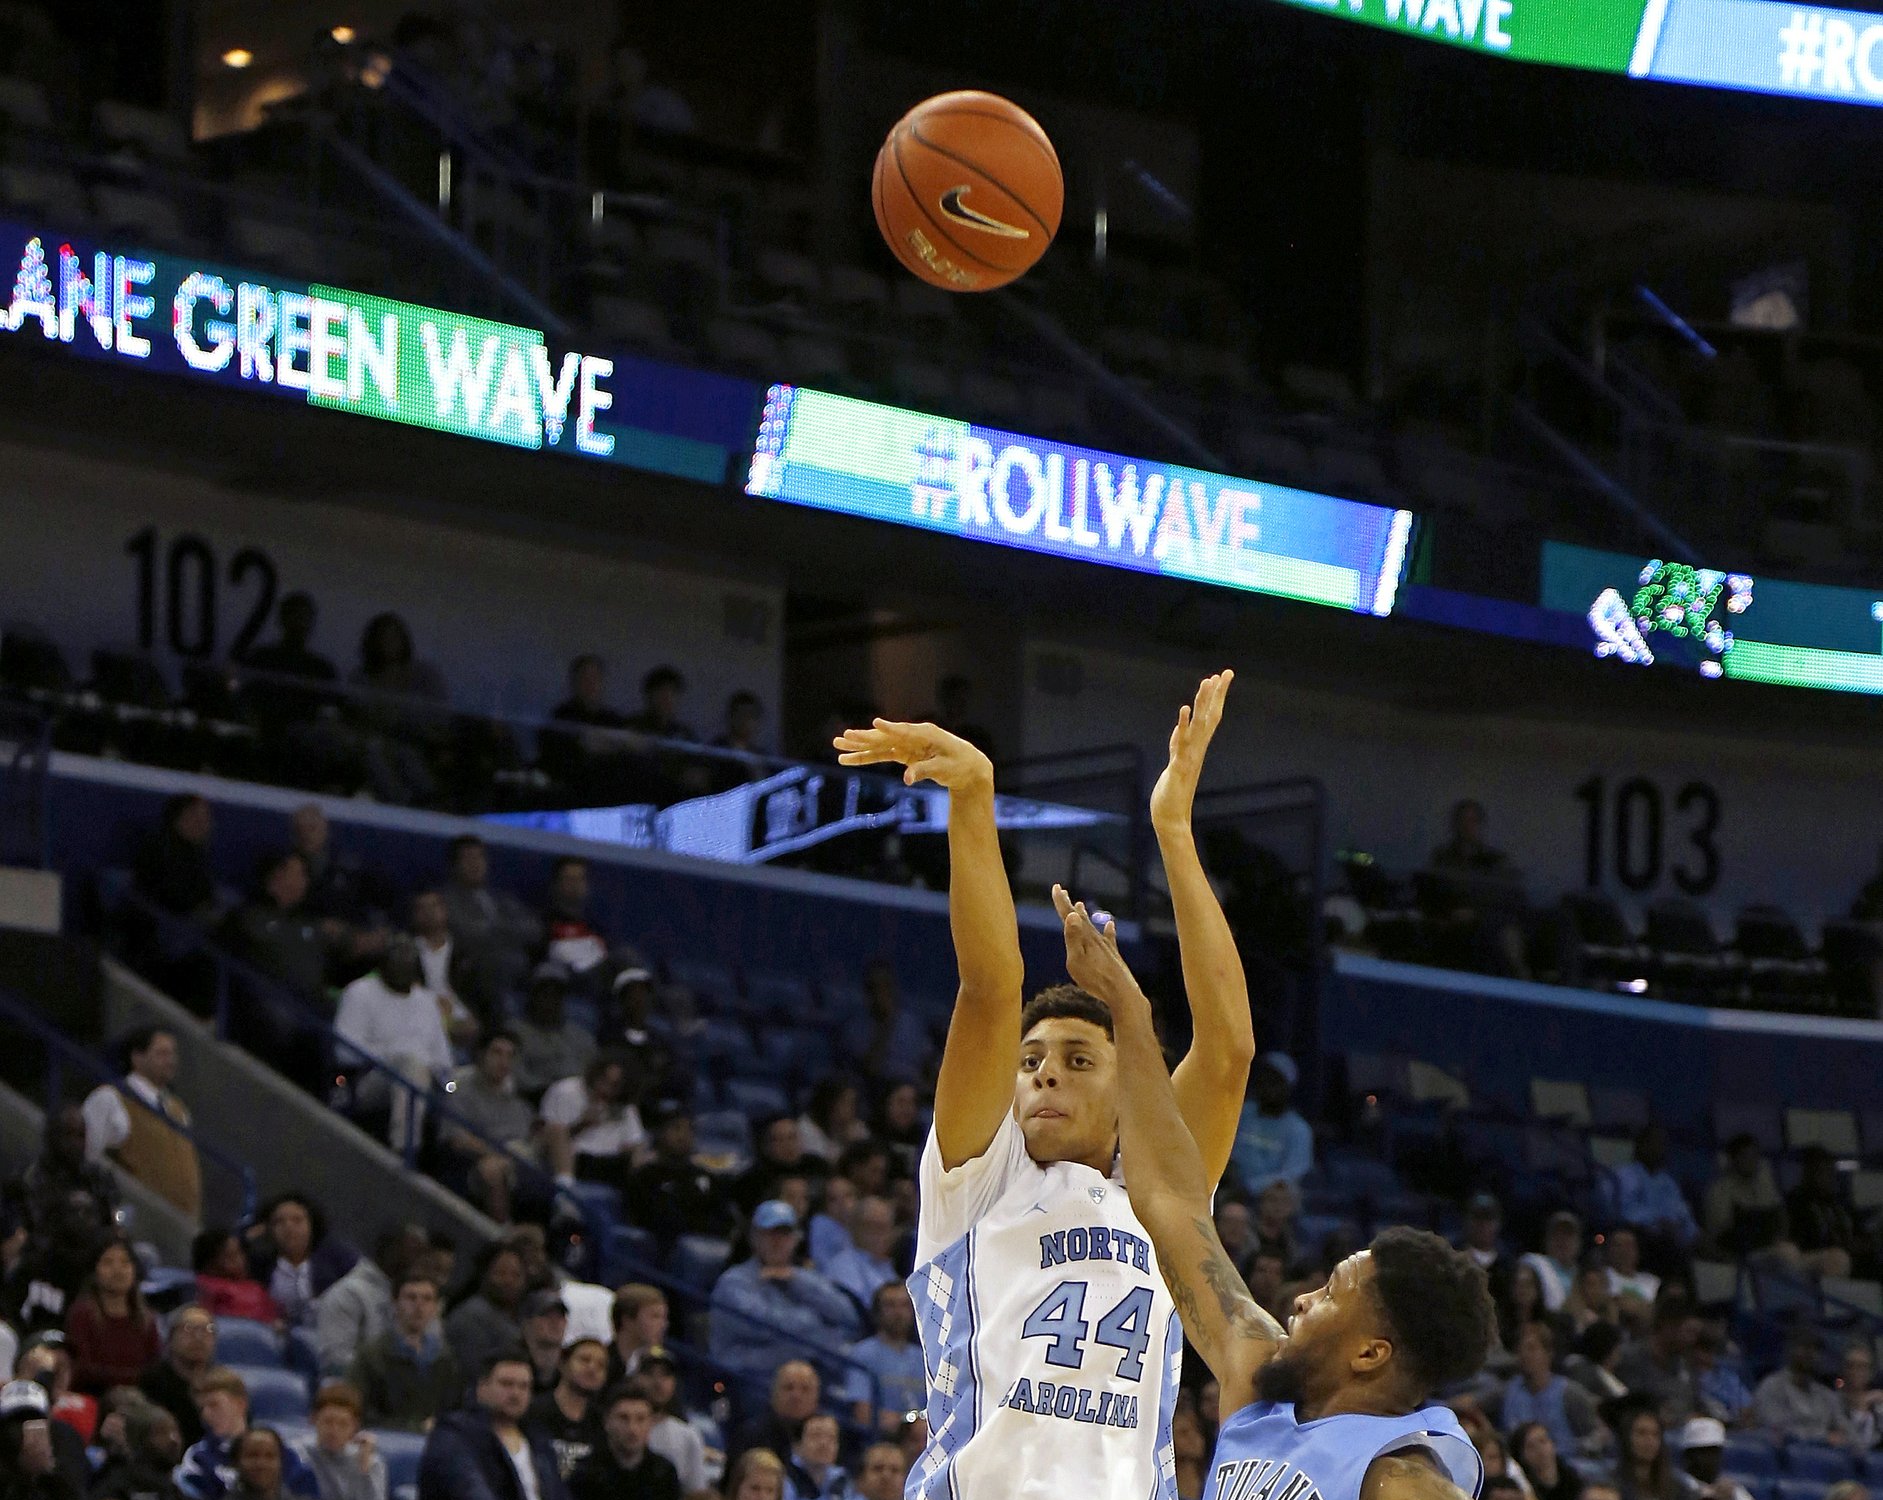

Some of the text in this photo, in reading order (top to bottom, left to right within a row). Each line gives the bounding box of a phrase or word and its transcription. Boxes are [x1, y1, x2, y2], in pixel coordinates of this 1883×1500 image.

[0, 237, 616, 456] ANE GREEN WAVE
[912, 423, 1262, 570] #ROLLWAVE
[124, 526, 278, 668] 102
[1577, 775, 1720, 895] 103
[1040, 1226, 1151, 1276] NORTH
[1021, 1281, 1155, 1383] 44
